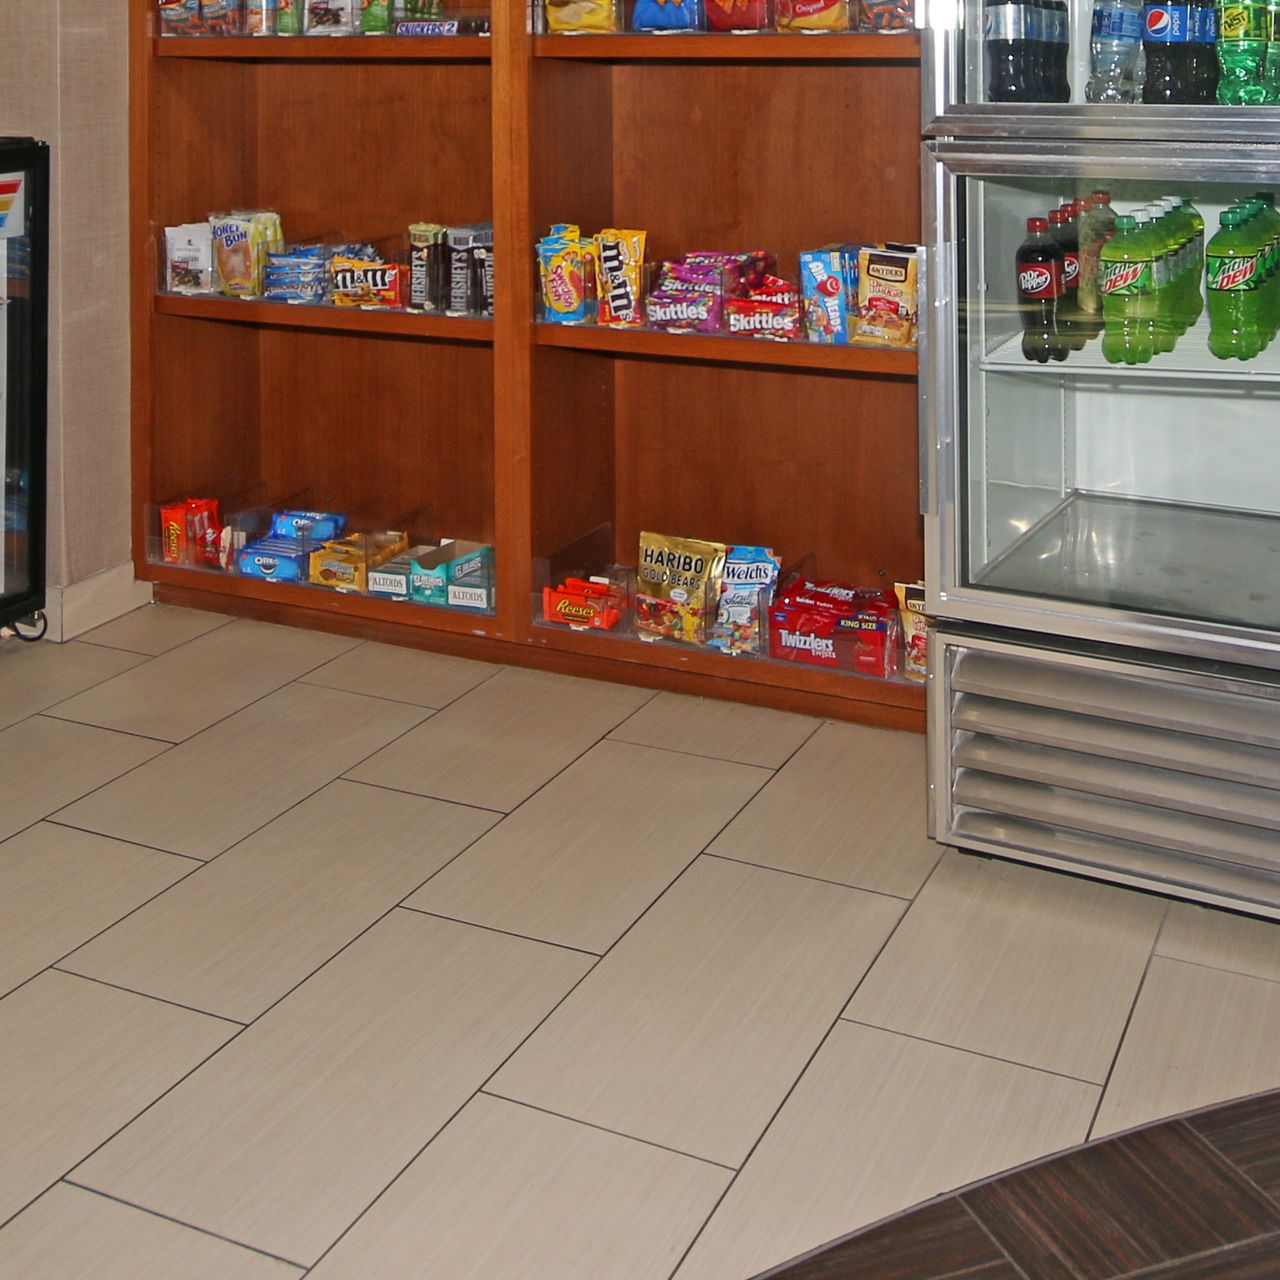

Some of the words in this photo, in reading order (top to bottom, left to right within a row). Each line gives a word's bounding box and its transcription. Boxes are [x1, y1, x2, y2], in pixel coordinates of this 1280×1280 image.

[795, 0, 825, 13] Original
[398, 22, 443, 35] SNICKERS
[224, 231, 248, 249] BUN
[1020, 272, 1047, 290] Pepper
[646, 304, 708, 321] Skittles
[729, 314, 794, 331] Skittles
[644, 548, 705, 574] HARIBO
[726, 564, 769, 580] Welch's
[372, 576, 404, 589] ALTOIDS
[452, 590, 484, 602] ALTOIDS
[841, 620, 860, 629] KING
[860, 622, 877, 630] SIZE
[780, 629, 835, 652] Twizzlers
